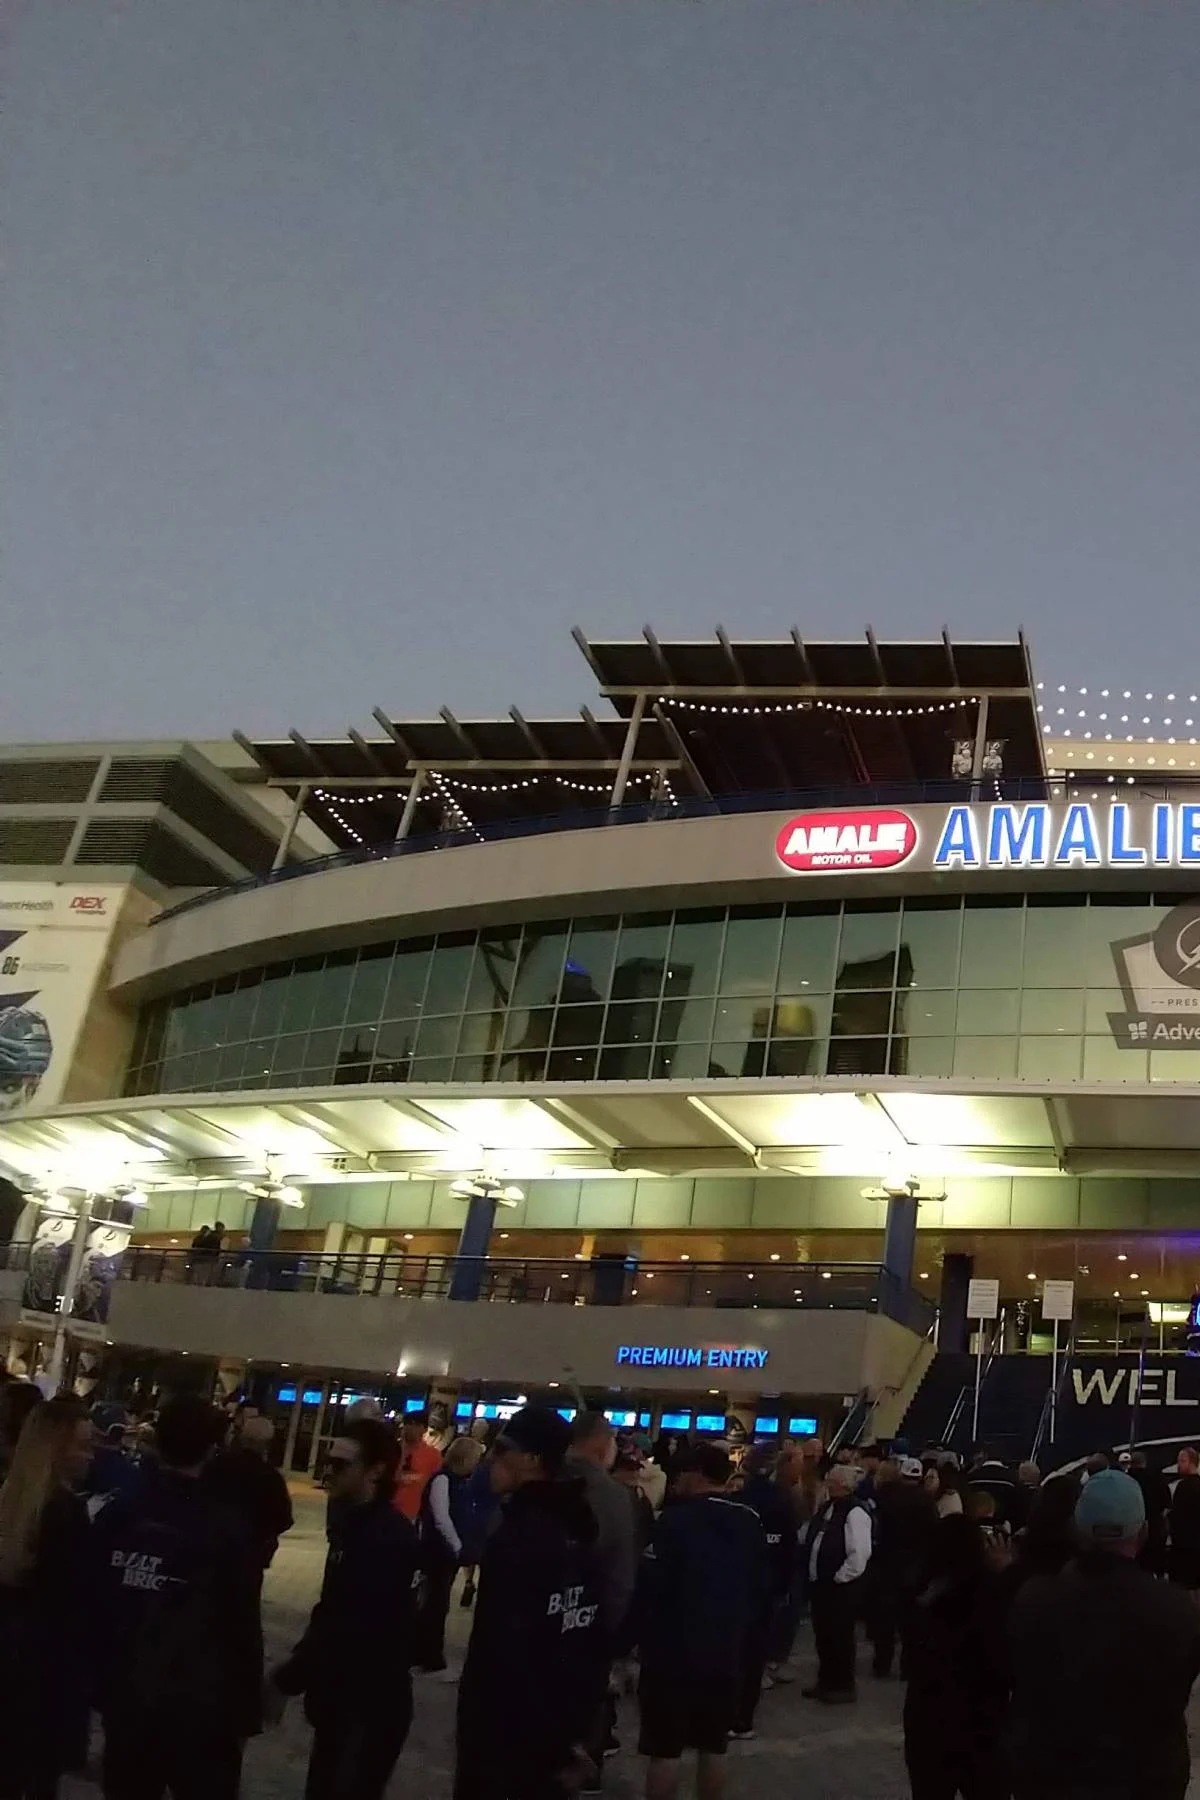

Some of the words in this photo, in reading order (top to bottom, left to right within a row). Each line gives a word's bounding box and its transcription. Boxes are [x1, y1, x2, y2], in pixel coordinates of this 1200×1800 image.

[784, 823, 907, 854] AMALIE
[811, 854, 851, 865] MOTOR
[854, 853, 872, 864] OIL
[69, 896, 107, 909] DEX
[617, 1347, 703, 1366] PREMIUM
[707, 1349, 769, 1368] ENTRY
